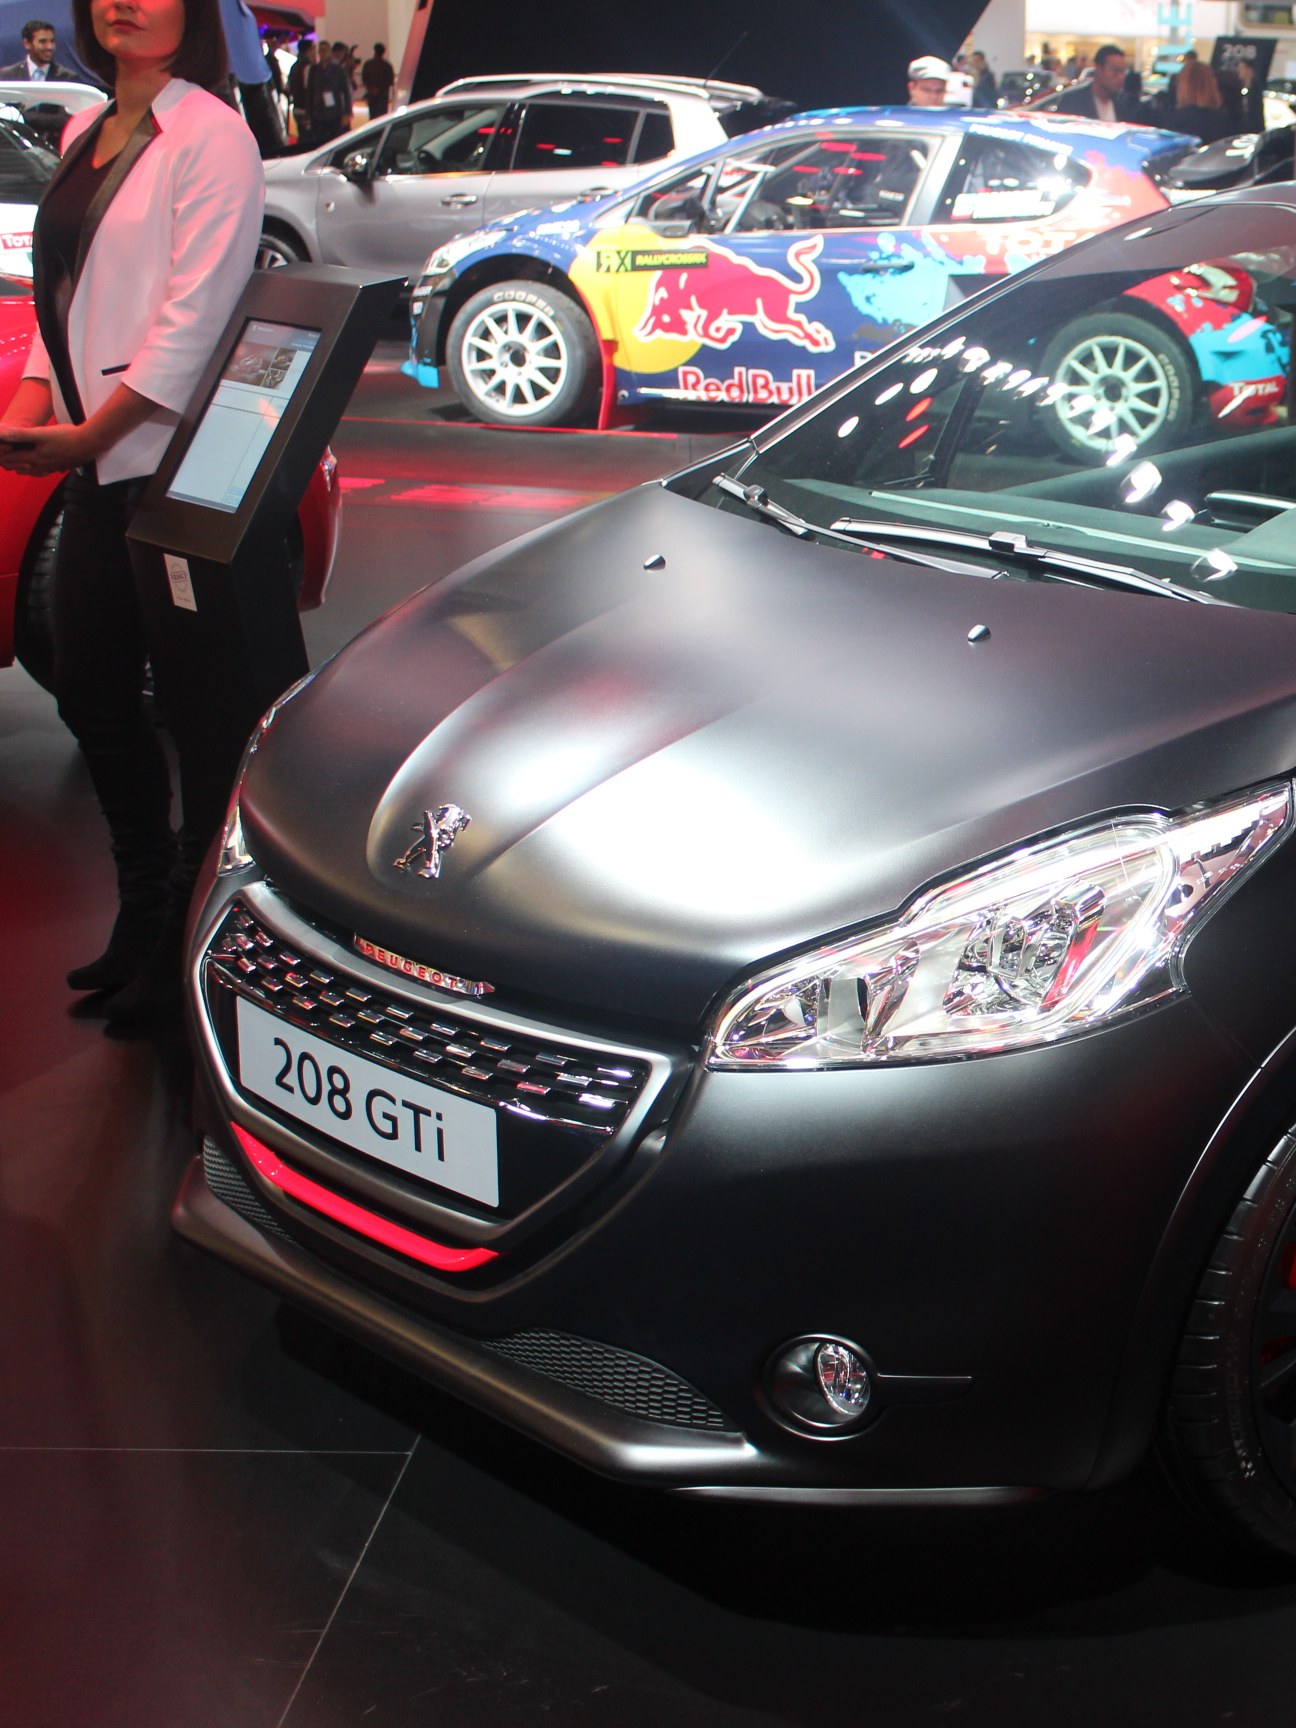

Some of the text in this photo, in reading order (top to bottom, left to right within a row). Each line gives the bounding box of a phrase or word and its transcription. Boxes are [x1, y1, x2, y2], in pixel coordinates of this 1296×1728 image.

[1222, 44, 1257, 59] 208
[493, 290, 555, 317] COOPER
[678, 366, 816, 405] Red Bull
[364, 943, 457, 989] PEUGEOT
[274, 1037, 445, 1162] 208 GTi
